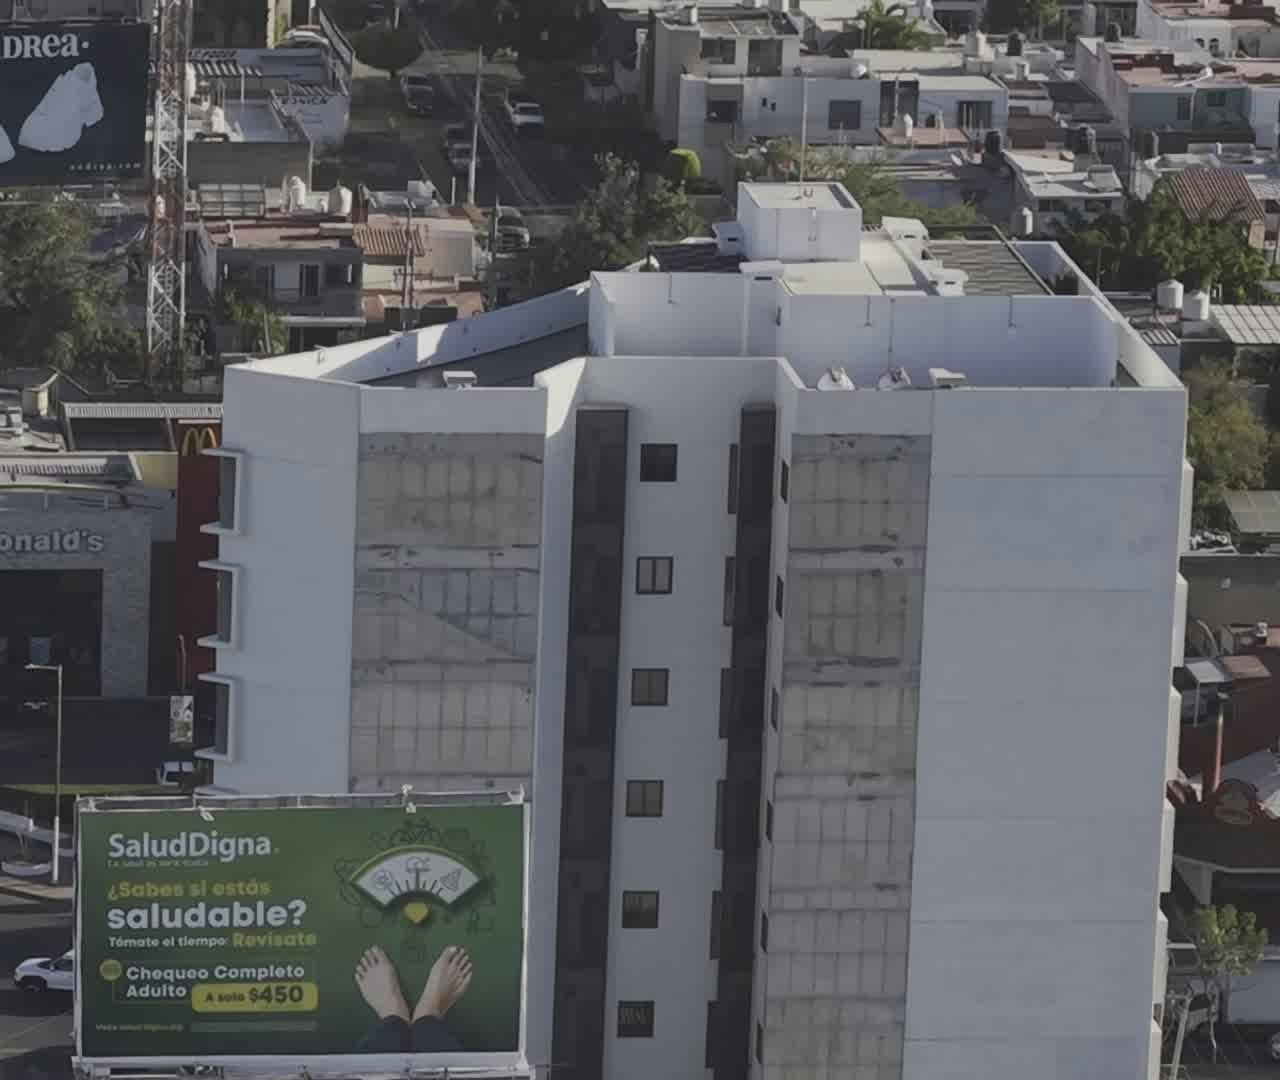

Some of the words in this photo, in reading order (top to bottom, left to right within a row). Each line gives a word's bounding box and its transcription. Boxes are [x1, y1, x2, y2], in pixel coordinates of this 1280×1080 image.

[107, 829, 272, 863] SaludDigna
[107, 899, 307, 930] saludable?
[109, 935, 159, 948] Tómate
[162, 935, 175, 947] el
[126, 965, 209, 984] Chequeo
[214, 963, 305, 982] Completo
[126, 983, 187, 999] Adulto
[248, 985, 304, 1005] $450
